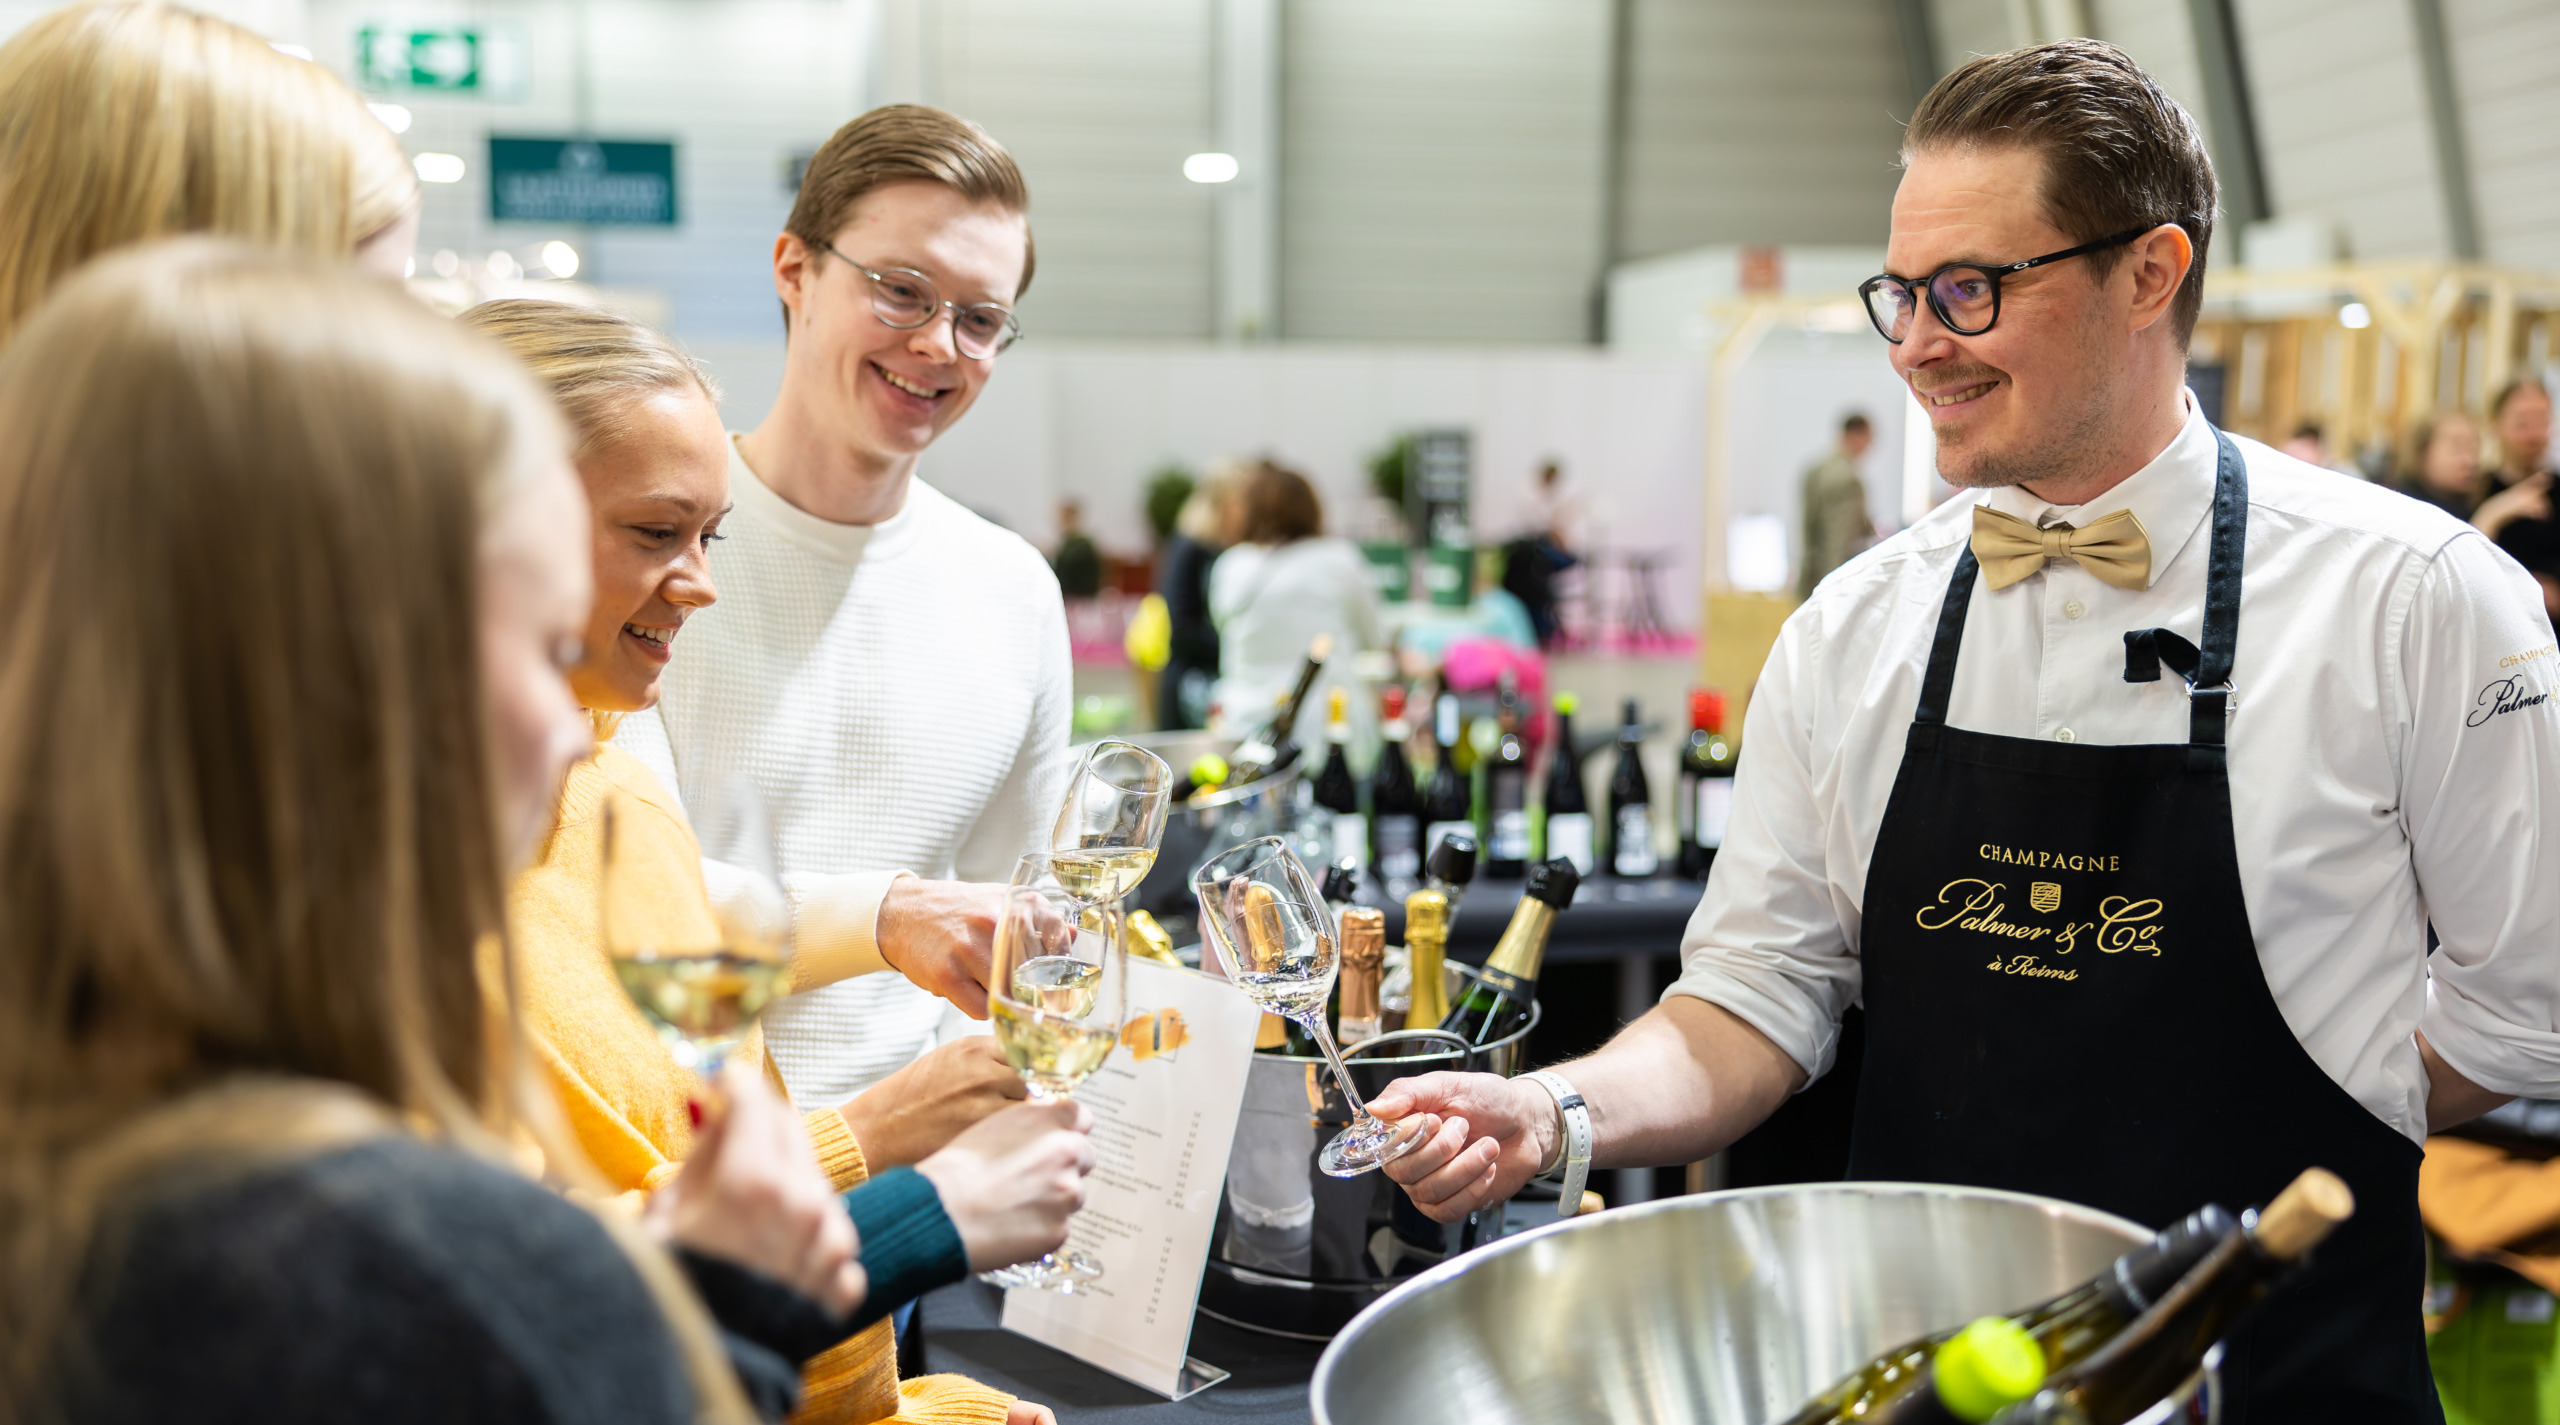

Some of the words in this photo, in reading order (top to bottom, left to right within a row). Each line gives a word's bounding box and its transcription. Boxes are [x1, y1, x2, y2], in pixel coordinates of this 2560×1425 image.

[2466, 674, 2548, 727] Palmer
[1979, 844, 2120, 872] CHAMPAGNE
[1916, 878, 2051, 940] Palmer
[2055, 922, 2094, 954] &
[1987, 955, 2003, 971] à
[2005, 955, 2079, 981] Reims
